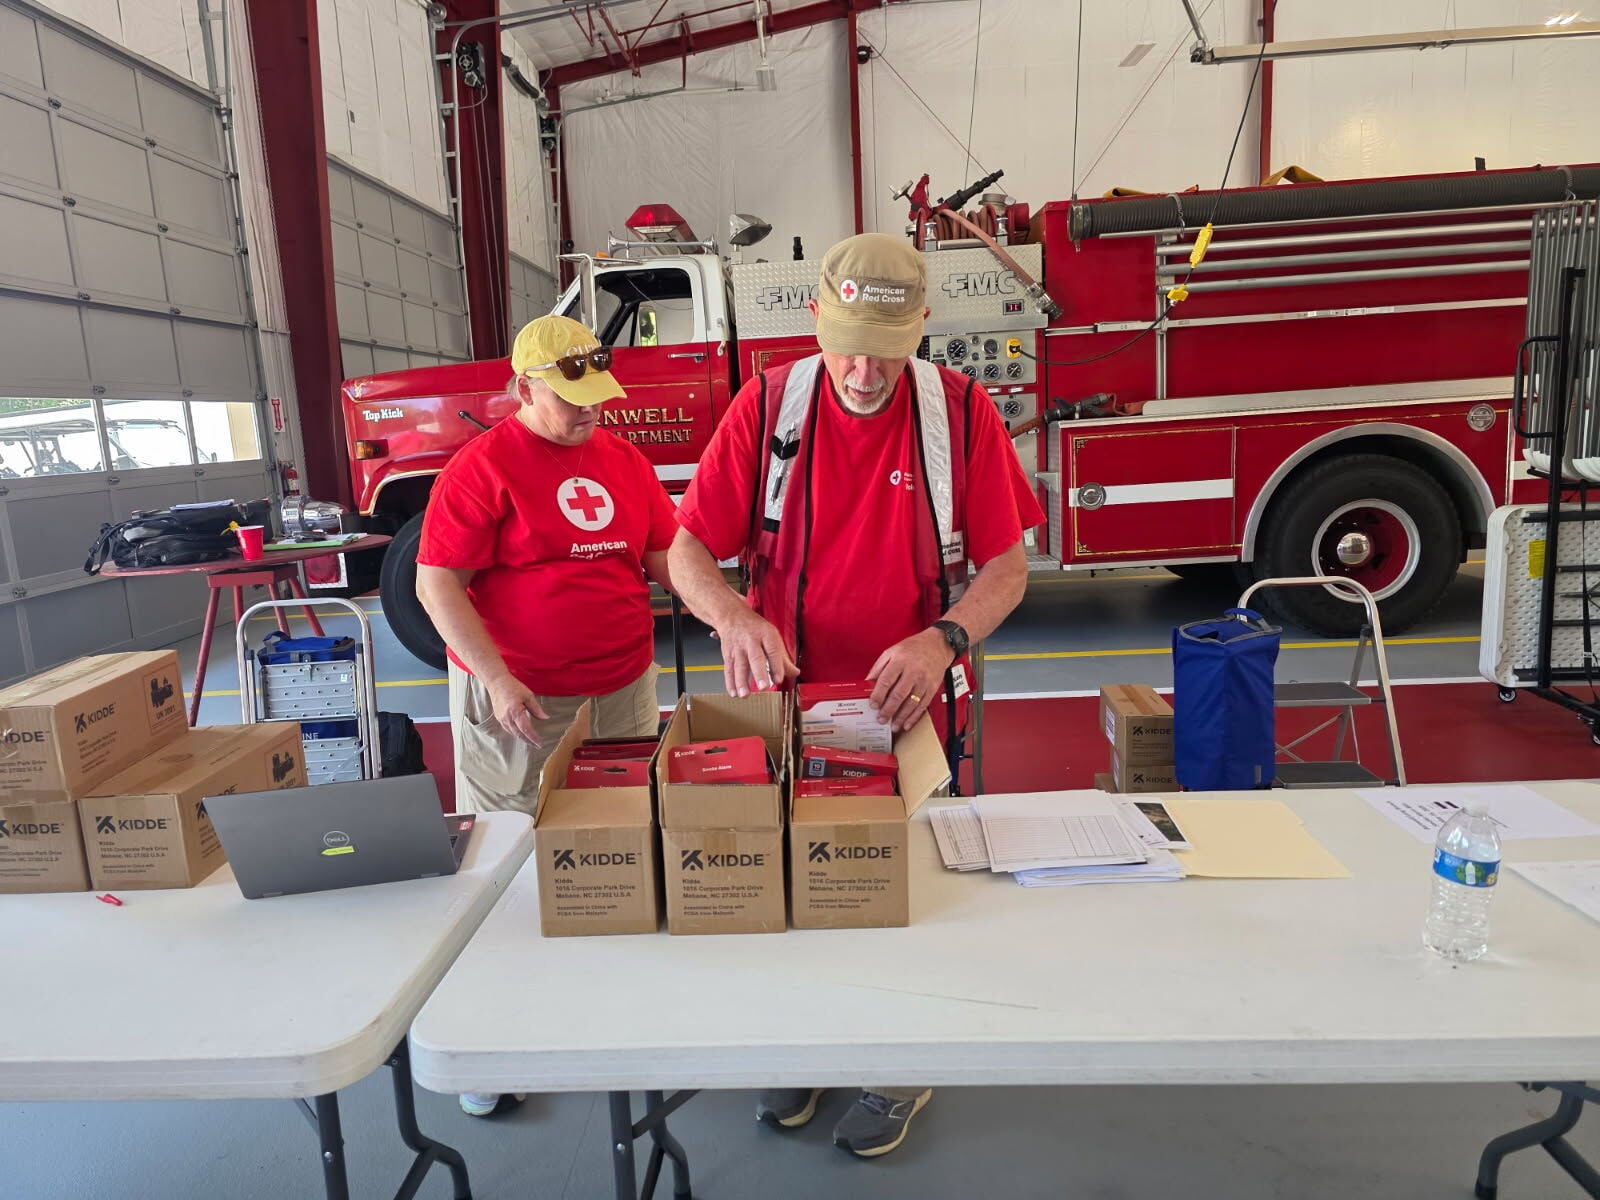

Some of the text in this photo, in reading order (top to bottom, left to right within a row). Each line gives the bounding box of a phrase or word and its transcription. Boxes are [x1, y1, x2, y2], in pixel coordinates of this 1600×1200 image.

[863, 285, 905, 295] American
[941, 270, 1015, 298] FMC
[862, 293, 906, 303] Red Cross
[362, 407, 404, 422] Top Kick
[570, 540, 628, 554] American
[87, 703, 116, 726] KIDDE
[12, 823, 61, 835] KIDDE
[118, 818, 168, 831] KIDDE
[579, 852, 637, 866] KIDDE
[835, 846, 892, 859] KIDDE
[707, 853, 765, 867] KIDDE
